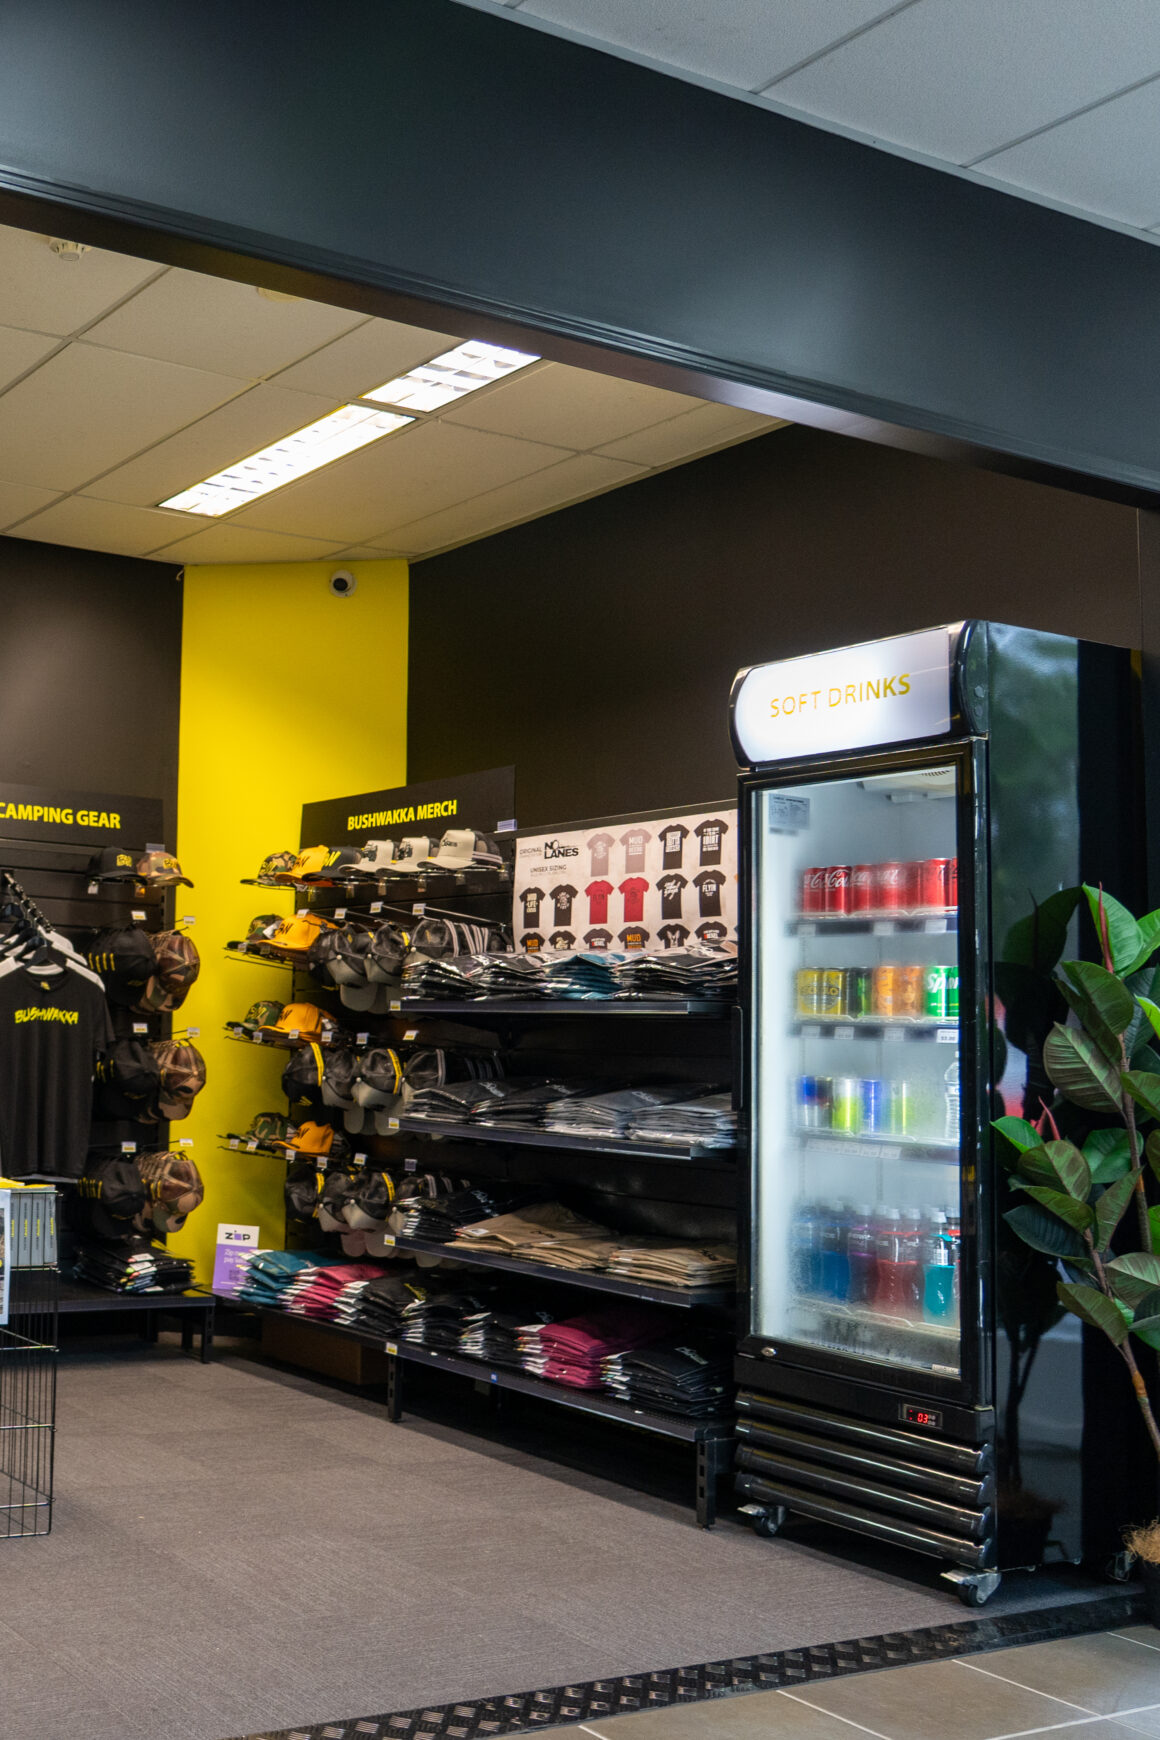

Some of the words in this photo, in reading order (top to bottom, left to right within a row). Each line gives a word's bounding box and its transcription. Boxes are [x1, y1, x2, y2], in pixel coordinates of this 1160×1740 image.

[770, 690, 821, 718] SOFT
[828, 673, 911, 707] DRINKS
[76, 809, 121, 829] GEAR
[347, 806, 415, 831] BUSHWAKKA
[417, 799, 458, 820] MERCH
[544, 839, 560, 850] NO
[544, 847, 579, 859] LANES
[14, 1007, 79, 1025] BUSHWAKKA
